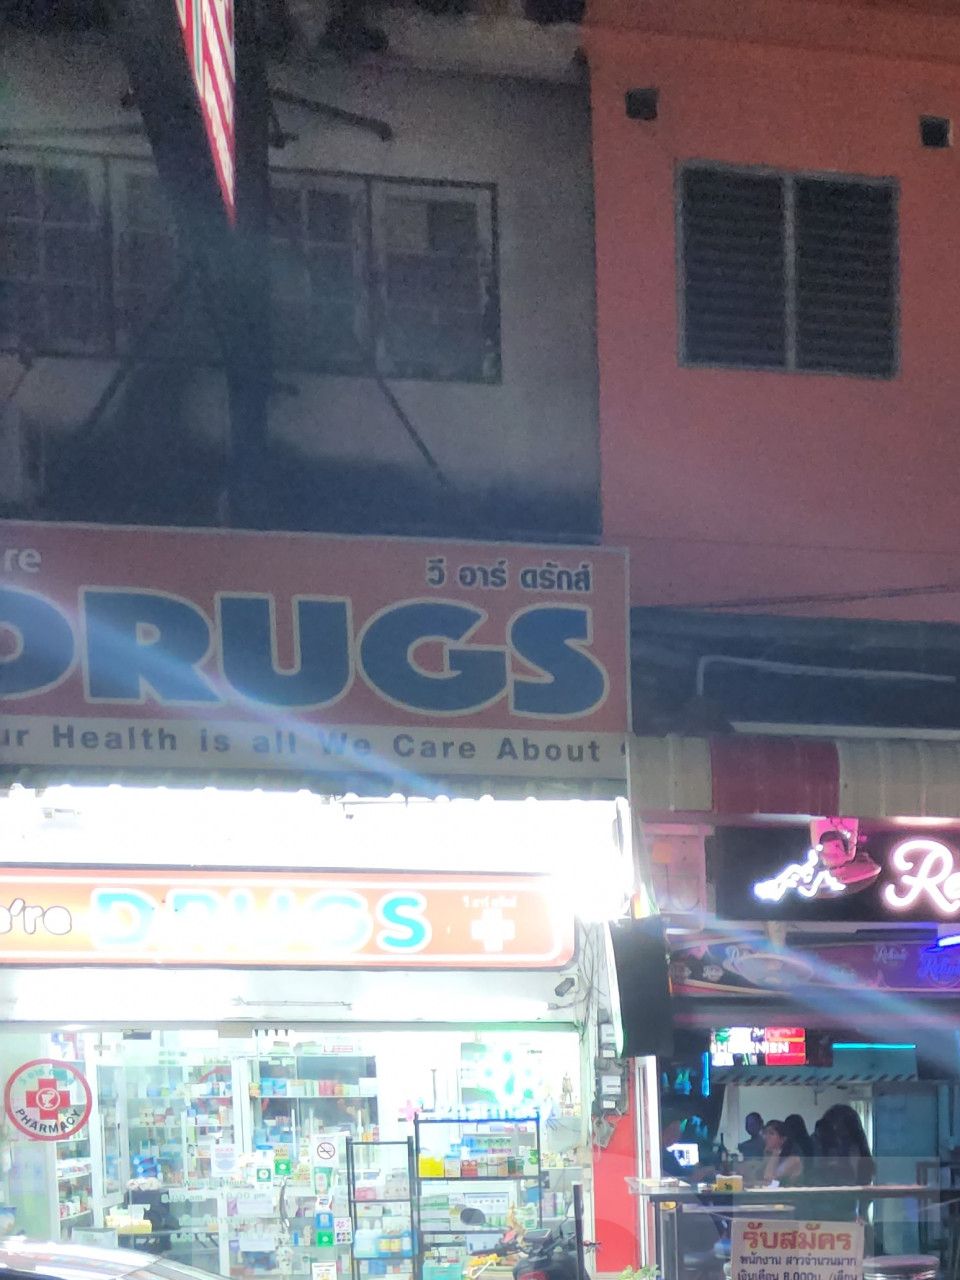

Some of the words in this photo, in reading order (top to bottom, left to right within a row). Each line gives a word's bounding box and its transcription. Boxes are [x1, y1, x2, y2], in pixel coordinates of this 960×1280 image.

[53, 724, 178, 751] Health
[200, 728, 231, 753] is
[252, 730, 297, 753] all
[318, 731, 371, 755] We
[393, 733, 477, 759] Care
[497, 737, 600, 762] About
[91, 888, 432, 953] DGS
[16, 1108, 80, 1133] PHARMACY
[743, 1222, 851, 1250] รับสมัคร
[740, 1251, 781, 1266] พนักงาน
